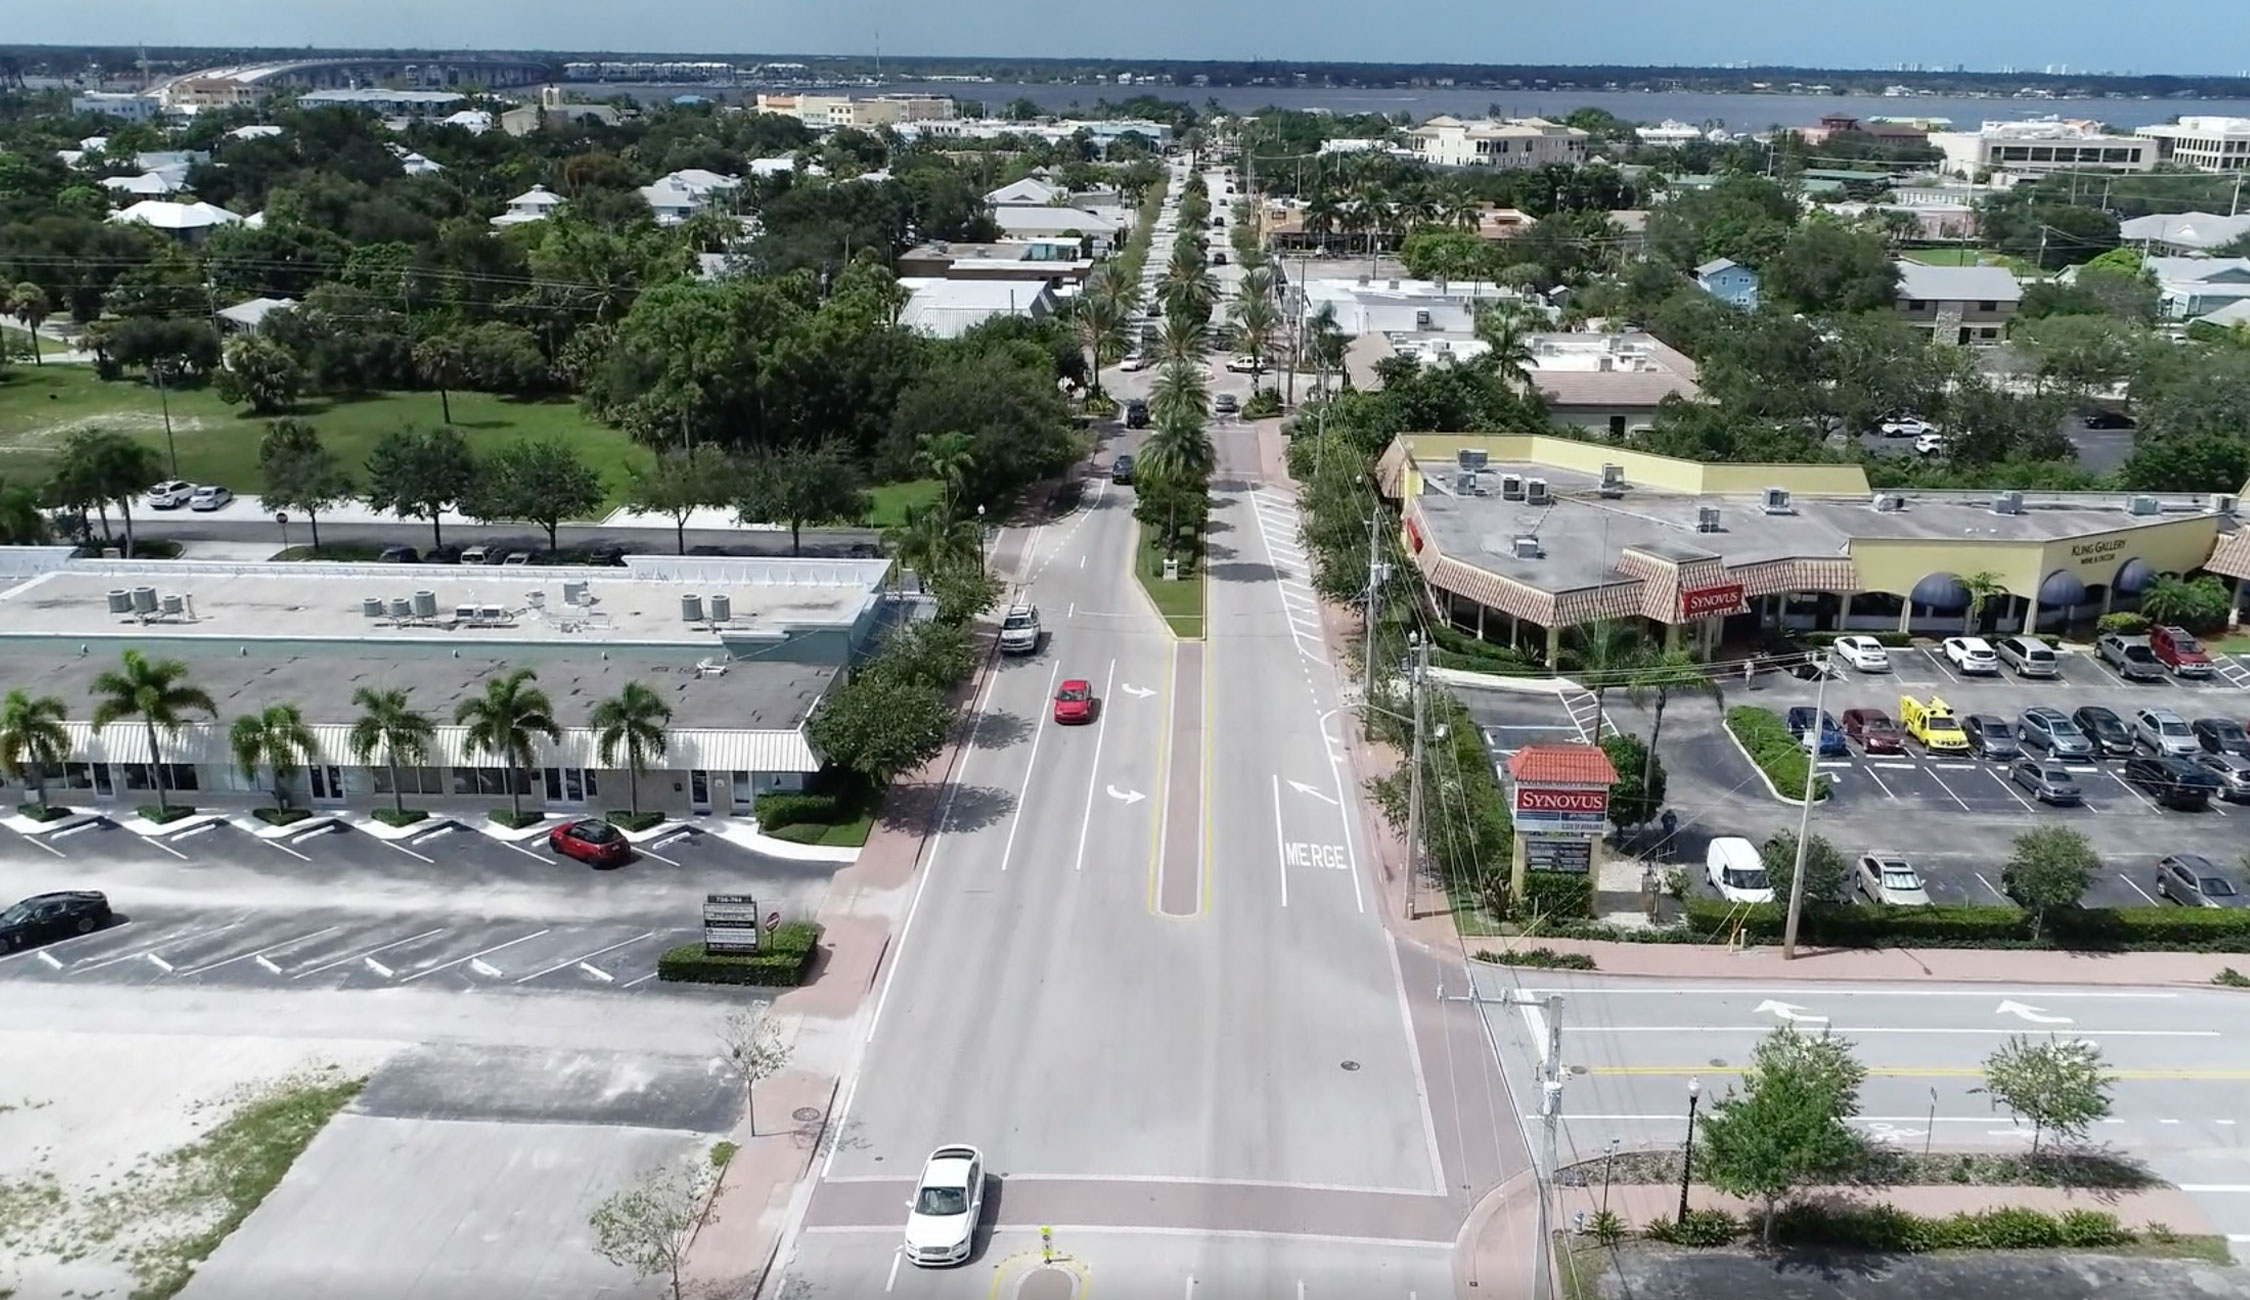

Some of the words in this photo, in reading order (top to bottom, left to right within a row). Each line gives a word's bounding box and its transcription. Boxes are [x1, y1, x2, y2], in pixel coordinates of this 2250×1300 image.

[2071, 543, 2094, 557] KLING
[2095, 539, 2127, 553] GALLERY
[1690, 592, 1738, 609] SYNOVUS
[1522, 791, 1603, 809] SYNOVUS
[1285, 842, 1347, 869] MERGE
